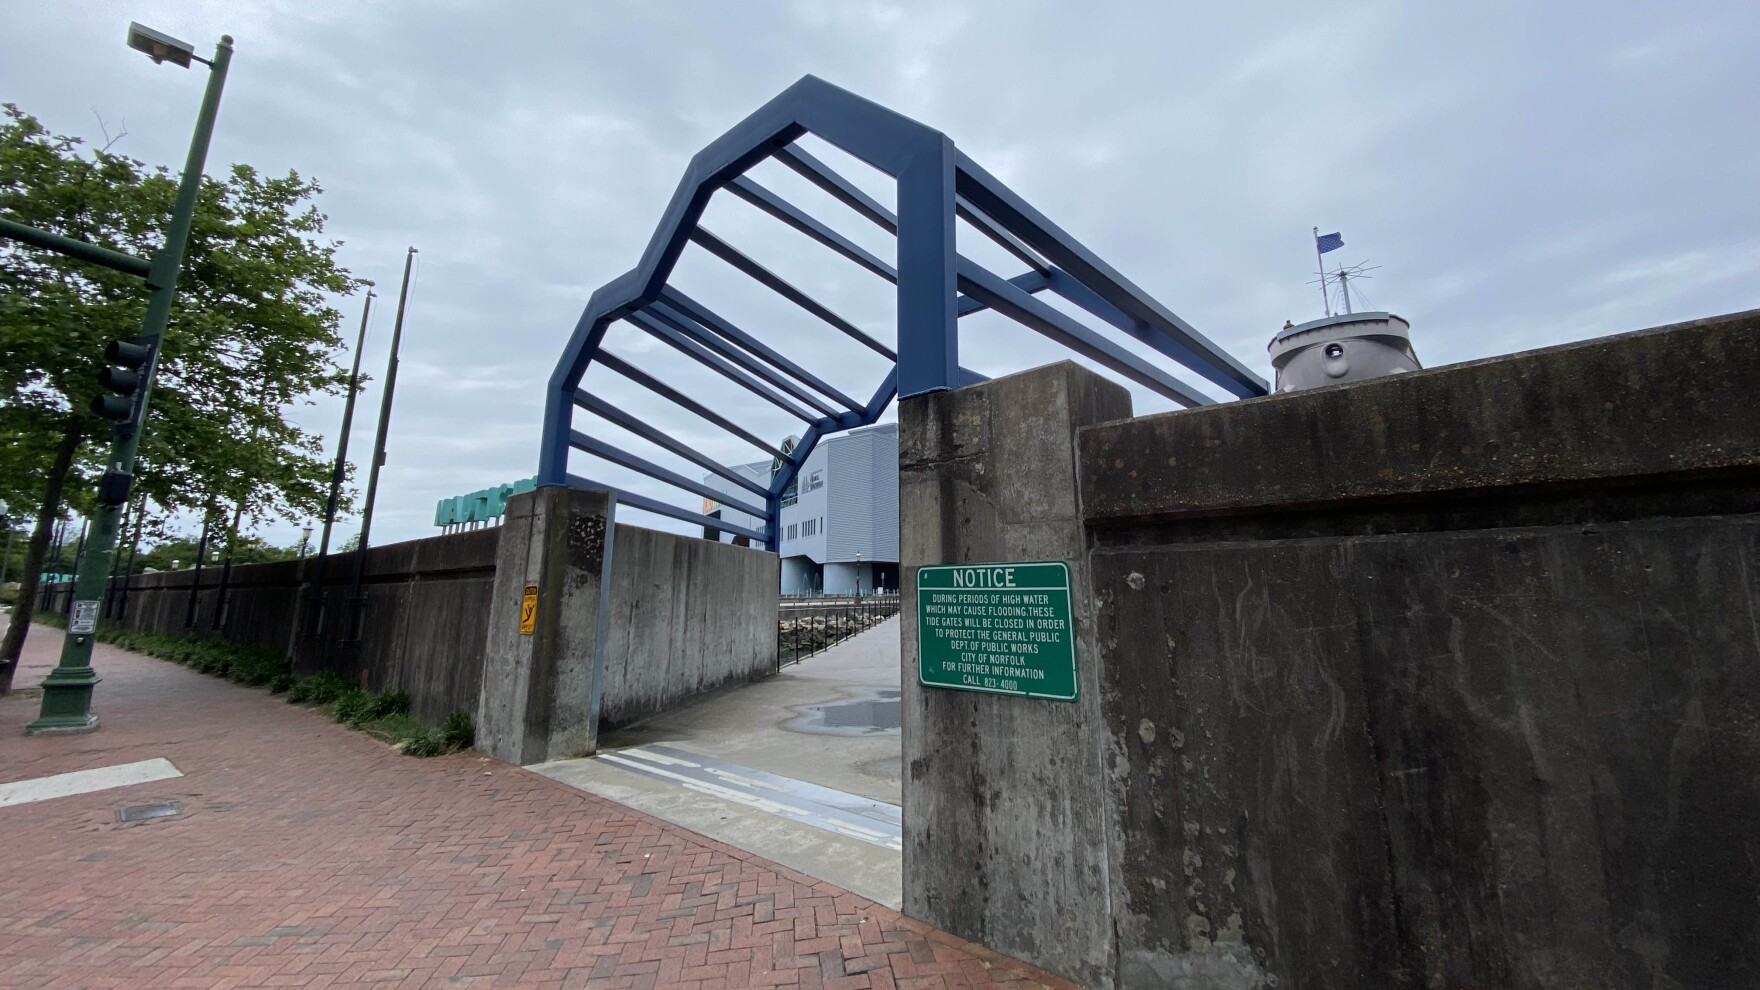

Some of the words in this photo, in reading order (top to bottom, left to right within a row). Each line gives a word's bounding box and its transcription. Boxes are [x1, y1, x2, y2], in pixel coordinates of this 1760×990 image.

[953, 568, 1016, 587] NOTICE
[932, 594, 957, 603] DURING
[959, 595, 988, 603] PERIODS
[991, 595, 999, 603] OF
[1002, 595, 1020, 604] HIGH
[1023, 595, 1048, 604] WATER
[926, 605, 946, 614] WHICH
[948, 606, 960, 615] MAY
[963, 606, 986, 615] CAUSE
[926, 617, 939, 625] TIDE
[942, 618, 962, 627] GATES
[964, 618, 980, 627] WILL
[982, 619, 992, 628] BE
[995, 619, 1023, 629] CLOSED
[1026, 619, 1034, 629] IN
[1037, 620, 1064, 629] ORDER
[935, 629, 943, 638] TO
[945, 629, 975, 639] PROTECT
[977, 631, 990, 640] THE
[993, 631, 1027, 641] GENERAL
[1030, 632, 1060, 642] PUBLIC
[969, 642, 979, 651] OF
[982, 642, 1008, 652] PUBLIC
[1011, 644, 1039, 654] WORKS
[962, 653, 976, 662] CITY
[978, 654, 987, 663] OF
[990, 655, 1025, 666] NORFOLK
[942, 662, 956, 671] FOR
[958, 663, 989, 674] FURTHER
[992, 666, 1044, 679] INFORMATION
[963, 675, 980, 685] CALL
[984, 678, 1018, 690] 823-4000
